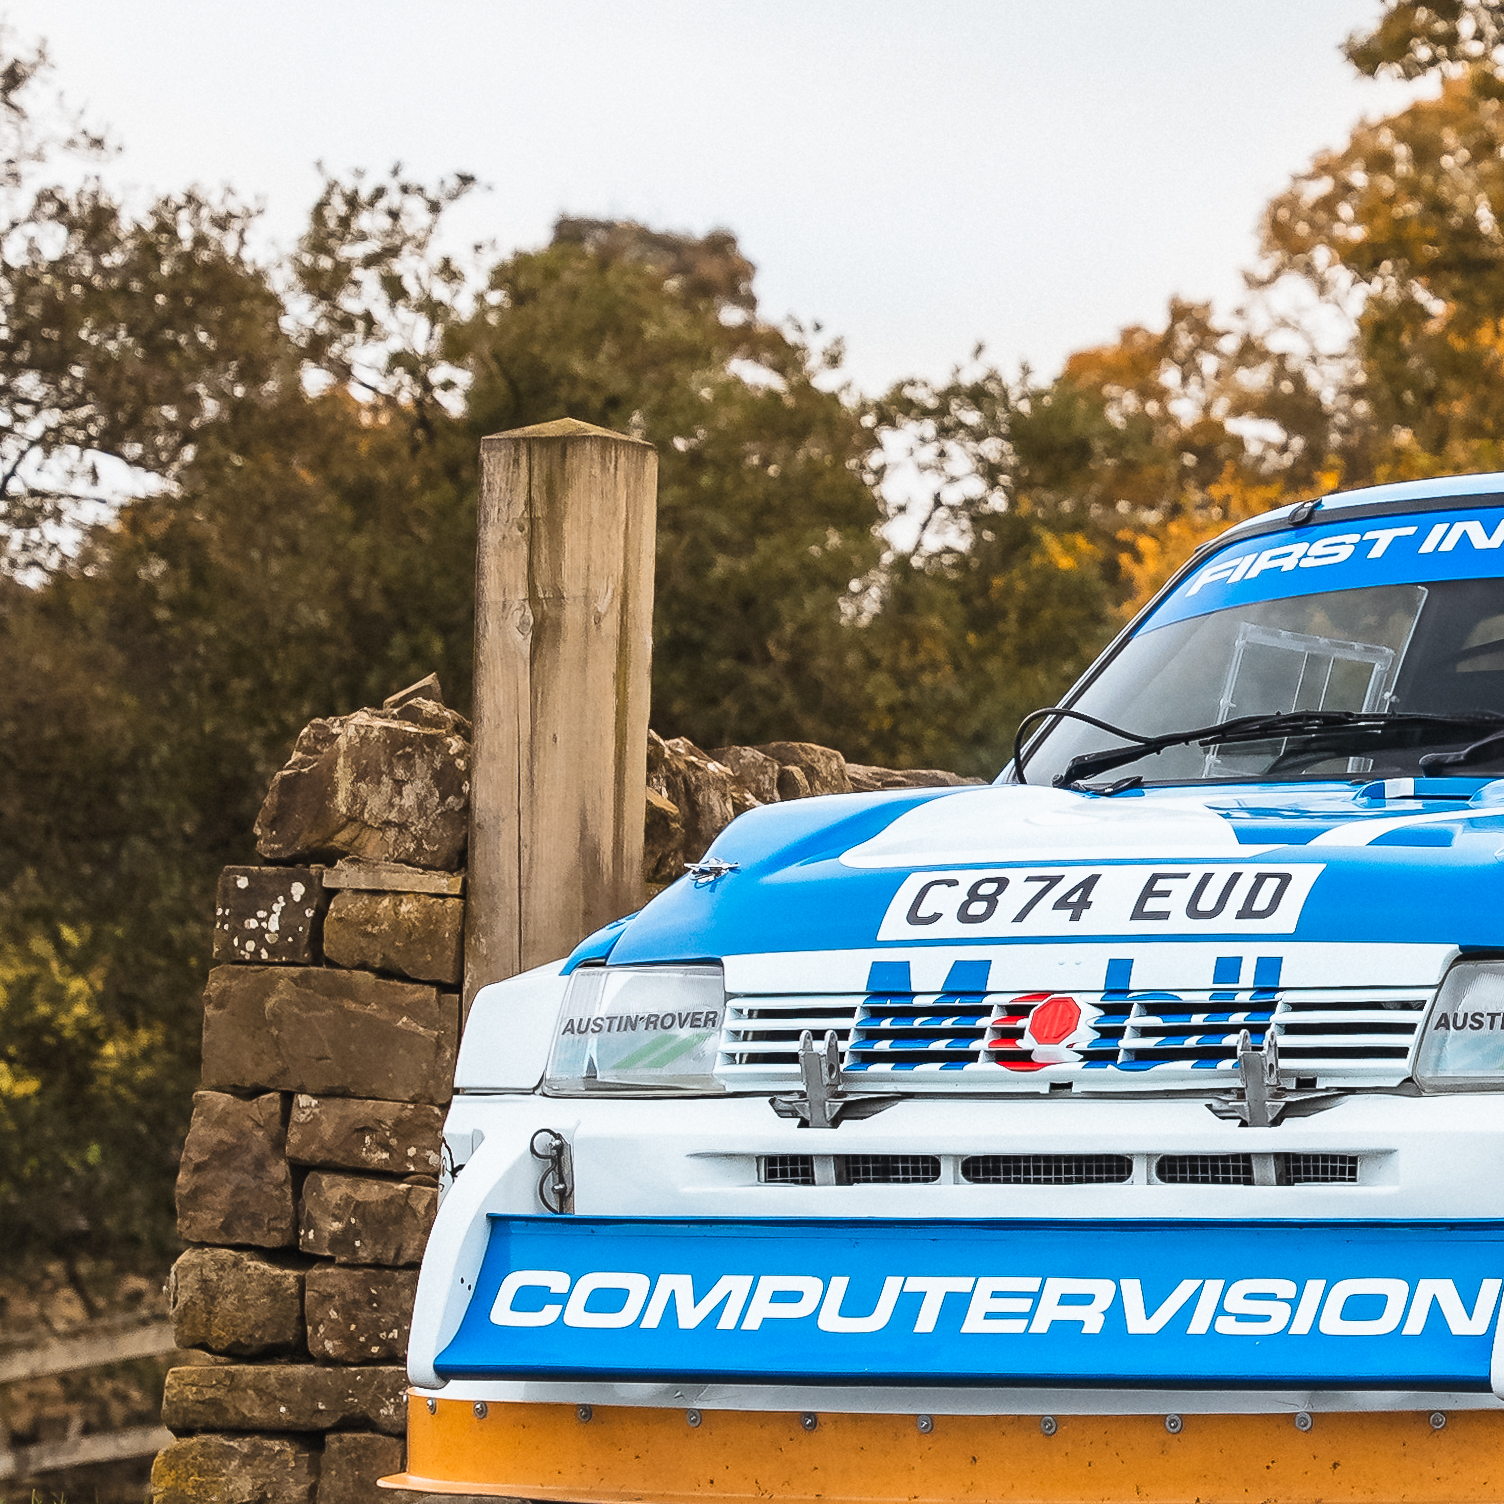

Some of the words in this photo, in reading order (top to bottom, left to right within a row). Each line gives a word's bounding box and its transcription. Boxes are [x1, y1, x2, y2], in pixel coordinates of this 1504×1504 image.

[1185, 526, 1419, 597] FIRST
[906, 872, 1102, 926] C874
[1130, 871, 1293, 921] EUD
[562, 1014, 641, 1036] AUSTIN
[644, 1010, 719, 1031] ROVER
[491, 1269, 1504, 1337] COMPUTERVISION
